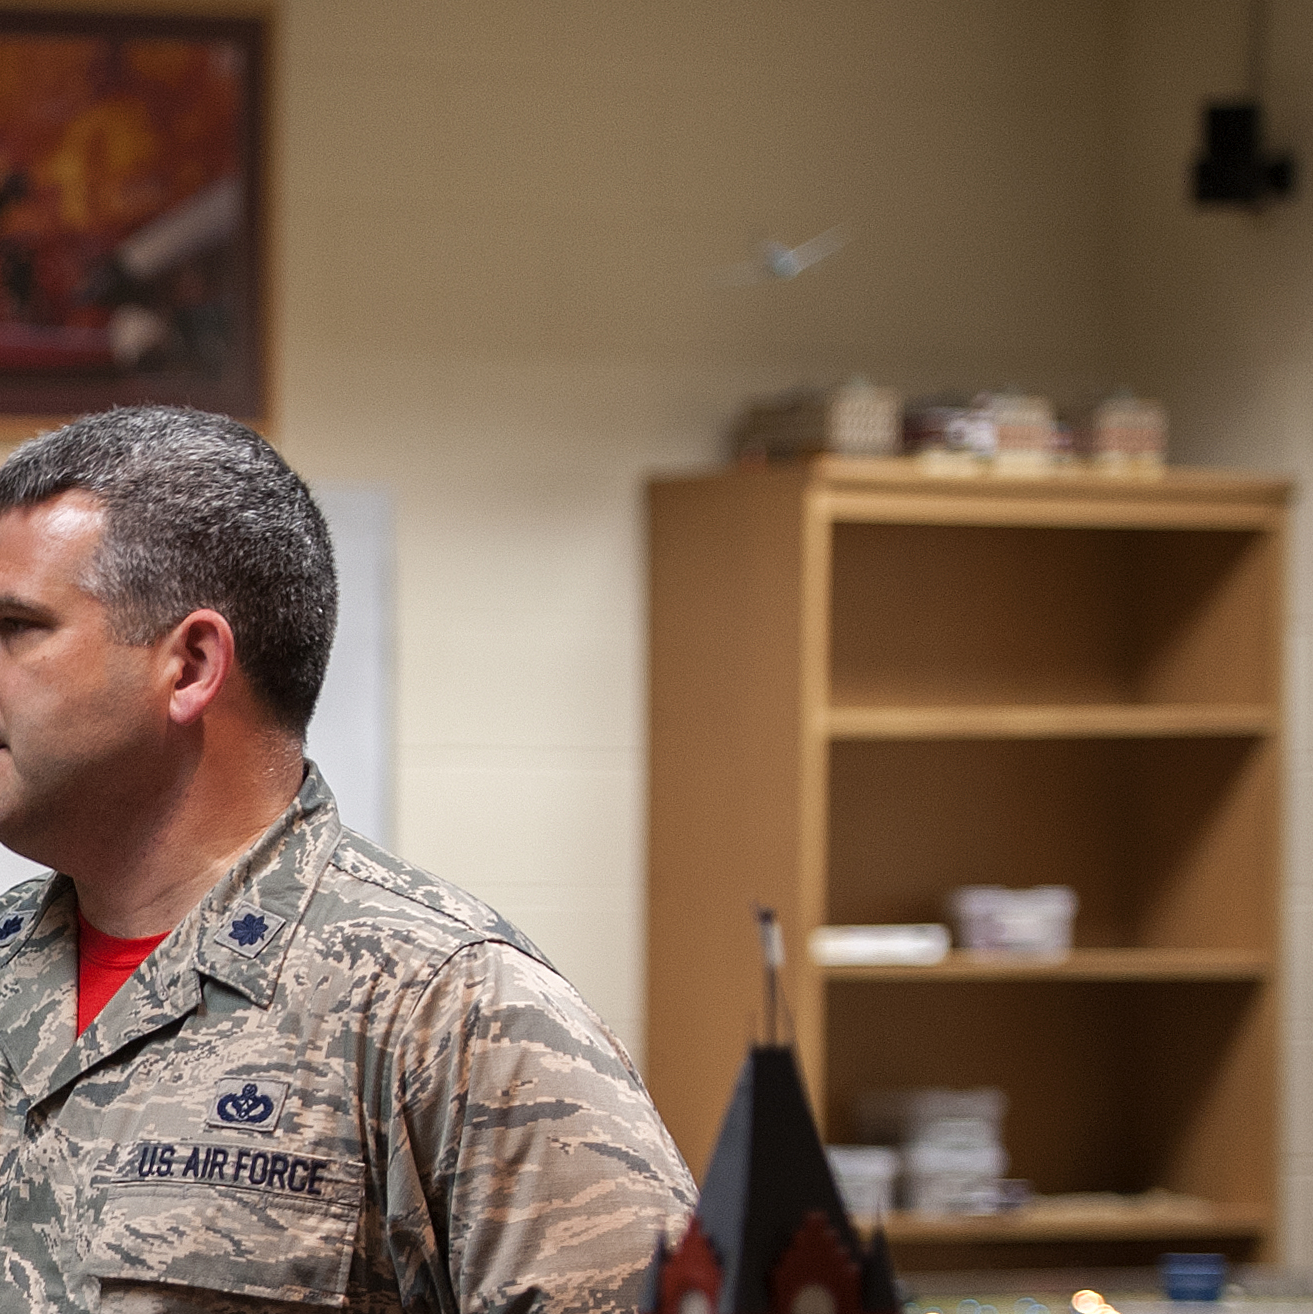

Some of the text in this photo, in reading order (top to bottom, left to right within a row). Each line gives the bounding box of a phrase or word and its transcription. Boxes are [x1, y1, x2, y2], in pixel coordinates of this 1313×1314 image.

[138, 1145, 327, 1195] U.S. AIR FORCE
